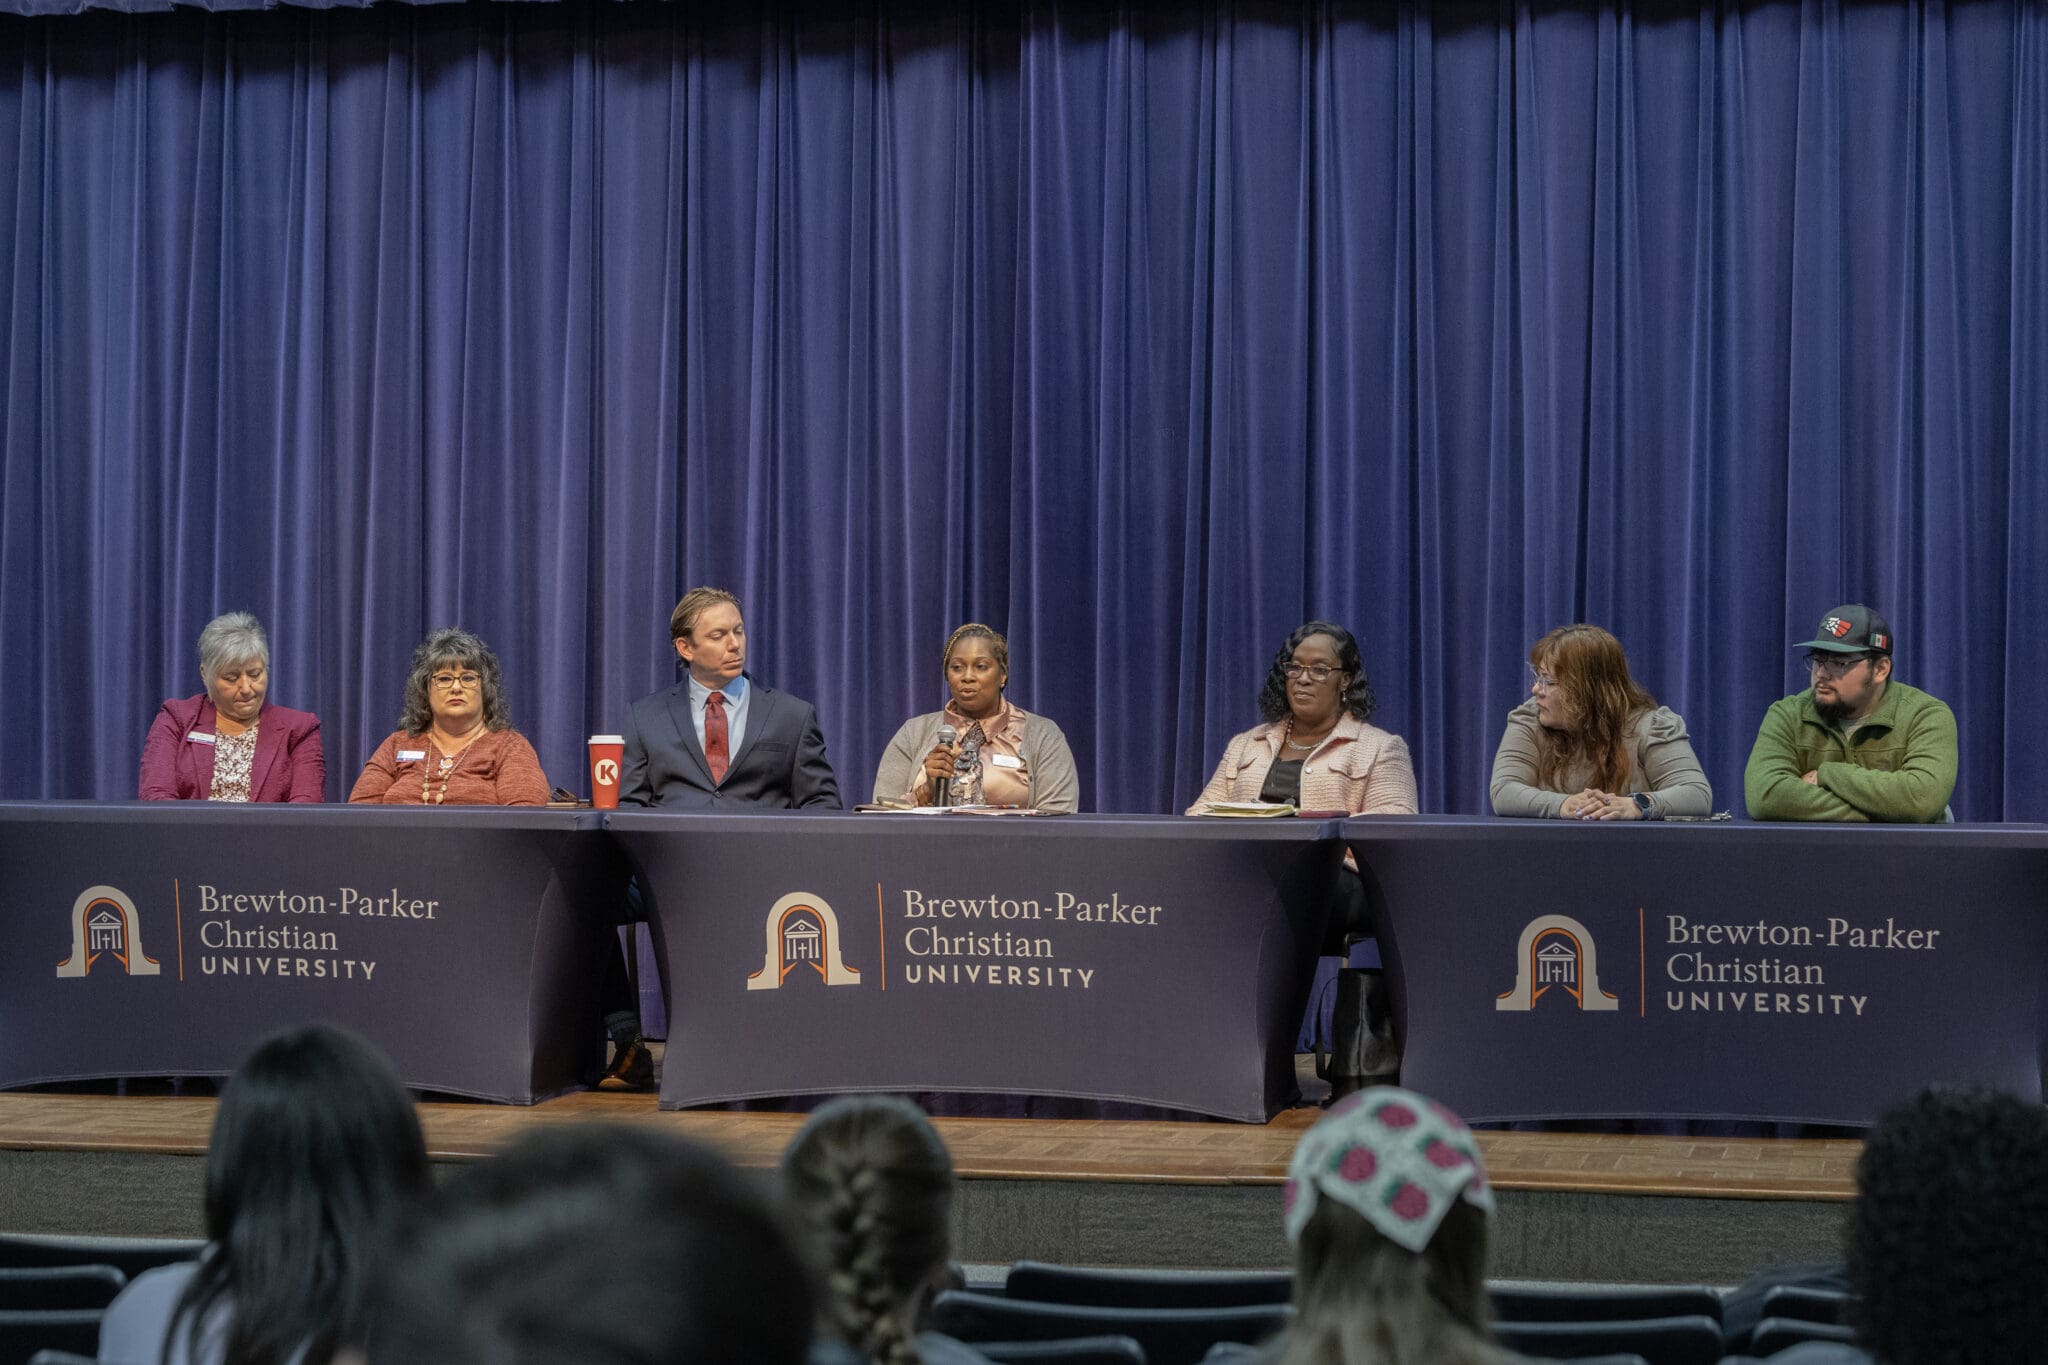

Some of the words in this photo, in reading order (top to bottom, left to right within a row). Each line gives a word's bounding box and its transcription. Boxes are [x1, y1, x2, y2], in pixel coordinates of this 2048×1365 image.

[599, 763, 617, 784] K
[199, 885, 439, 919] Brewton-Parker
[902, 889, 1162, 926] Brewton-Parker
[200, 920, 339, 951] Christian
[905, 926, 1054, 958] Christian
[1666, 915, 1940, 949] Brewton-Parker
[201, 956, 376, 980] UNIVERSITY
[905, 964, 1094, 989] UNIVERSITY
[1667, 952, 1825, 985] Christian
[1667, 991, 1867, 1016] UNIVERSITY
